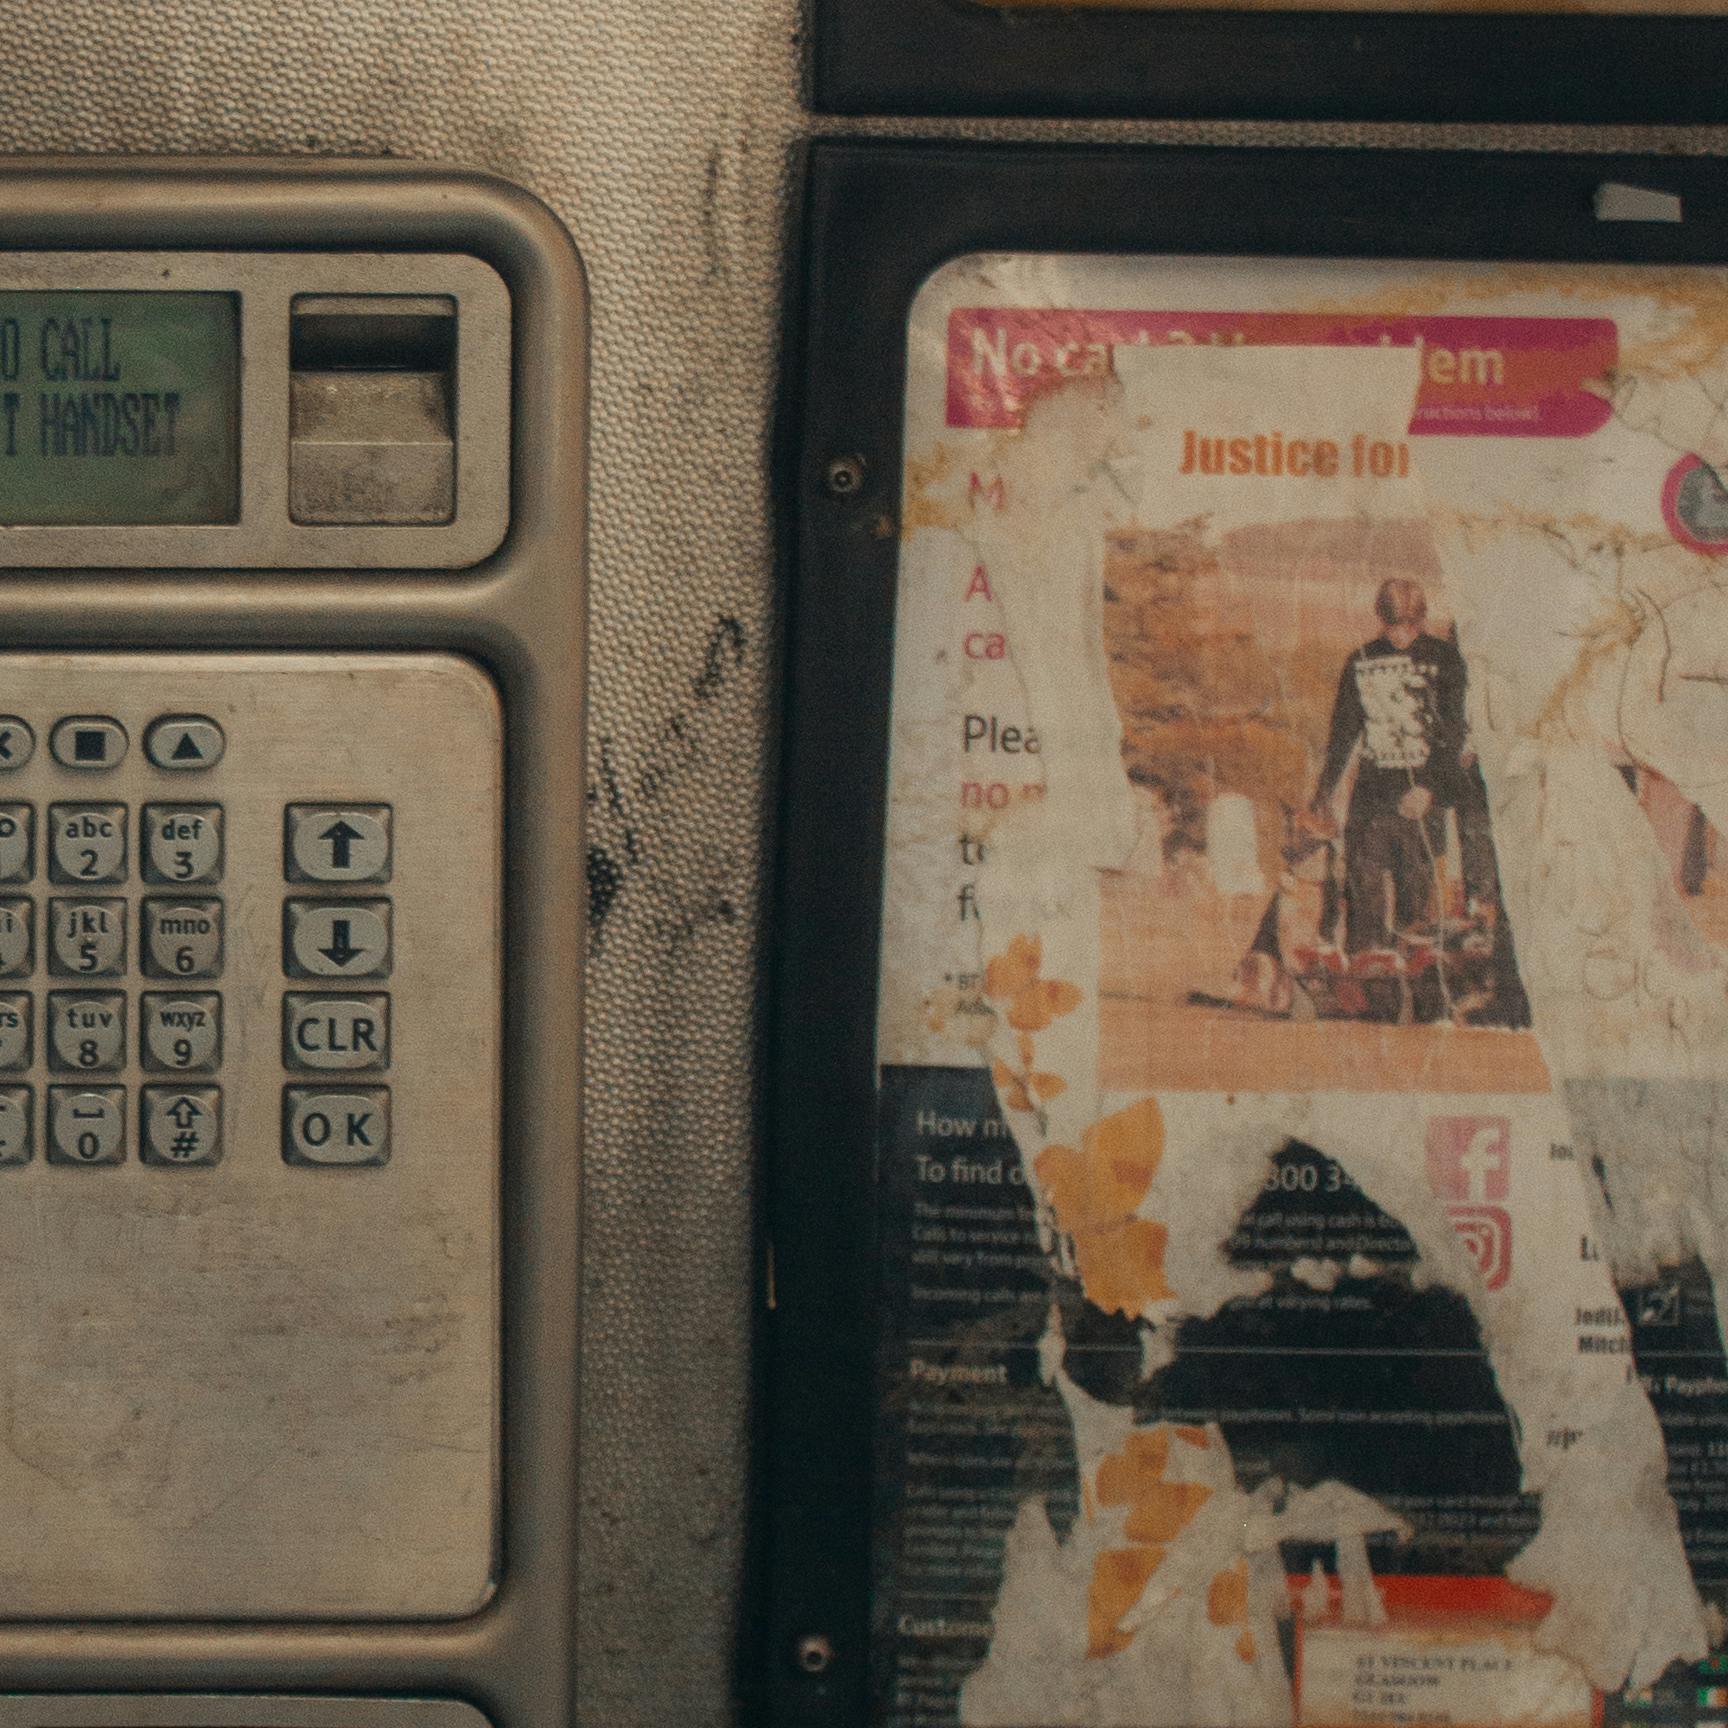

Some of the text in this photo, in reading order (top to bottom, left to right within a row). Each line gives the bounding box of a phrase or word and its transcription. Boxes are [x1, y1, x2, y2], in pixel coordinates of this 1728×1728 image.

[41, 316, 122, 383] CALL
[971, 327, 1042, 377] No
[39, 392, 183, 458] HANDSET
[1179, 430, 1341, 478] Justice
[964, 563, 995, 603] A
[963, 632, 1007, 661] ca
[960, 781, 1011, 810] no
[65, 821, 113, 839] abc
[161, 821, 204, 840] def
[80, 850, 99, 878] 2
[176, 850, 195, 878] 3
[68, 914, 110, 938] jkl
[159, 917, 211, 936] mno
[79, 944, 98, 971] 5
[175, 945, 194, 973] 6
[67, 1009, 113, 1030] tuv
[160, 1010, 206, 1033] wxyz
[297, 1017, 379, 1053] CLR
[79, 1040, 99, 1067] 8
[174, 1040, 193, 1067] 9
[302, 1112, 373, 1148] OK
[915, 1110, 976, 1138] How
[78, 1131, 99, 1160] 0
[913, 1155, 946, 1183] To
[951, 1156, 1003, 1185] find
[909, 1357, 1009, 1386] Payment
